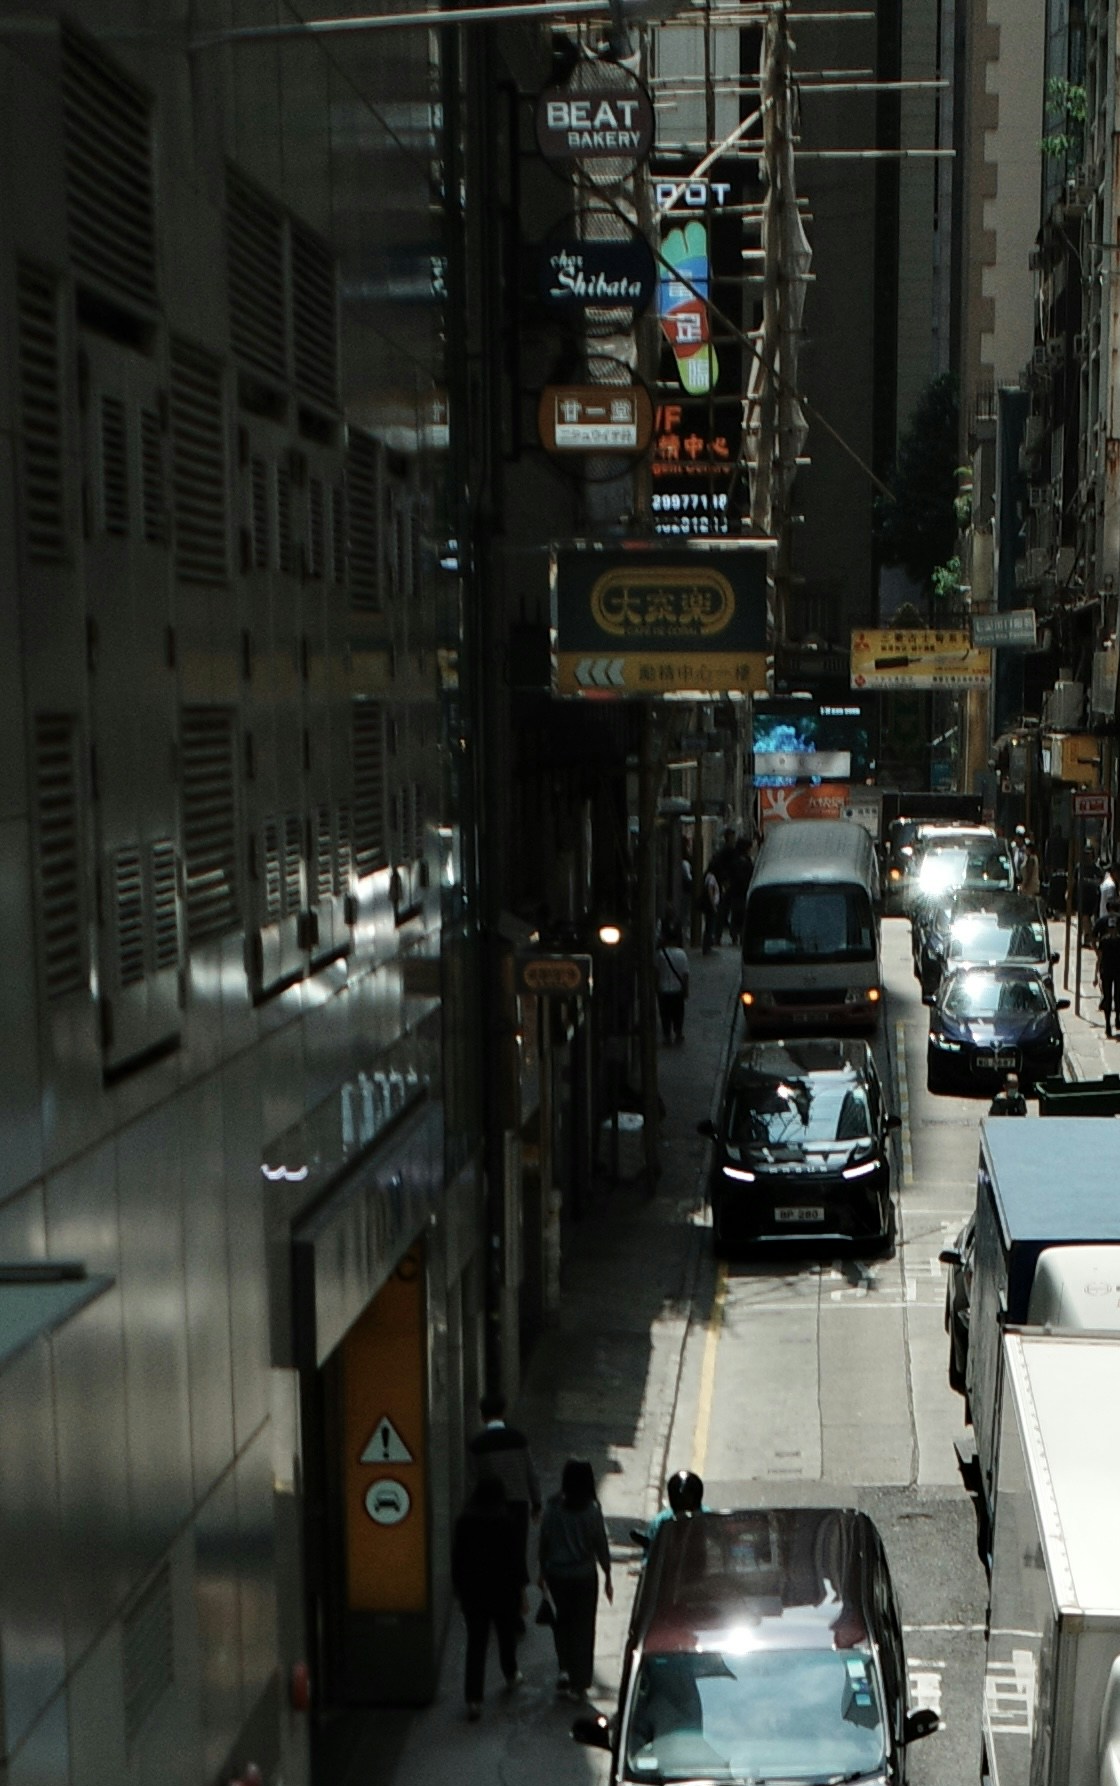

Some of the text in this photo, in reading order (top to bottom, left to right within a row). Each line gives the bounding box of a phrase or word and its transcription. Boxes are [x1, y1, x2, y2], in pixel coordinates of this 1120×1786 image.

[547, 100, 639, 129] BEAT
[568, 131, 641, 149] BAKERY
[549, 266, 642, 298] Shibata
